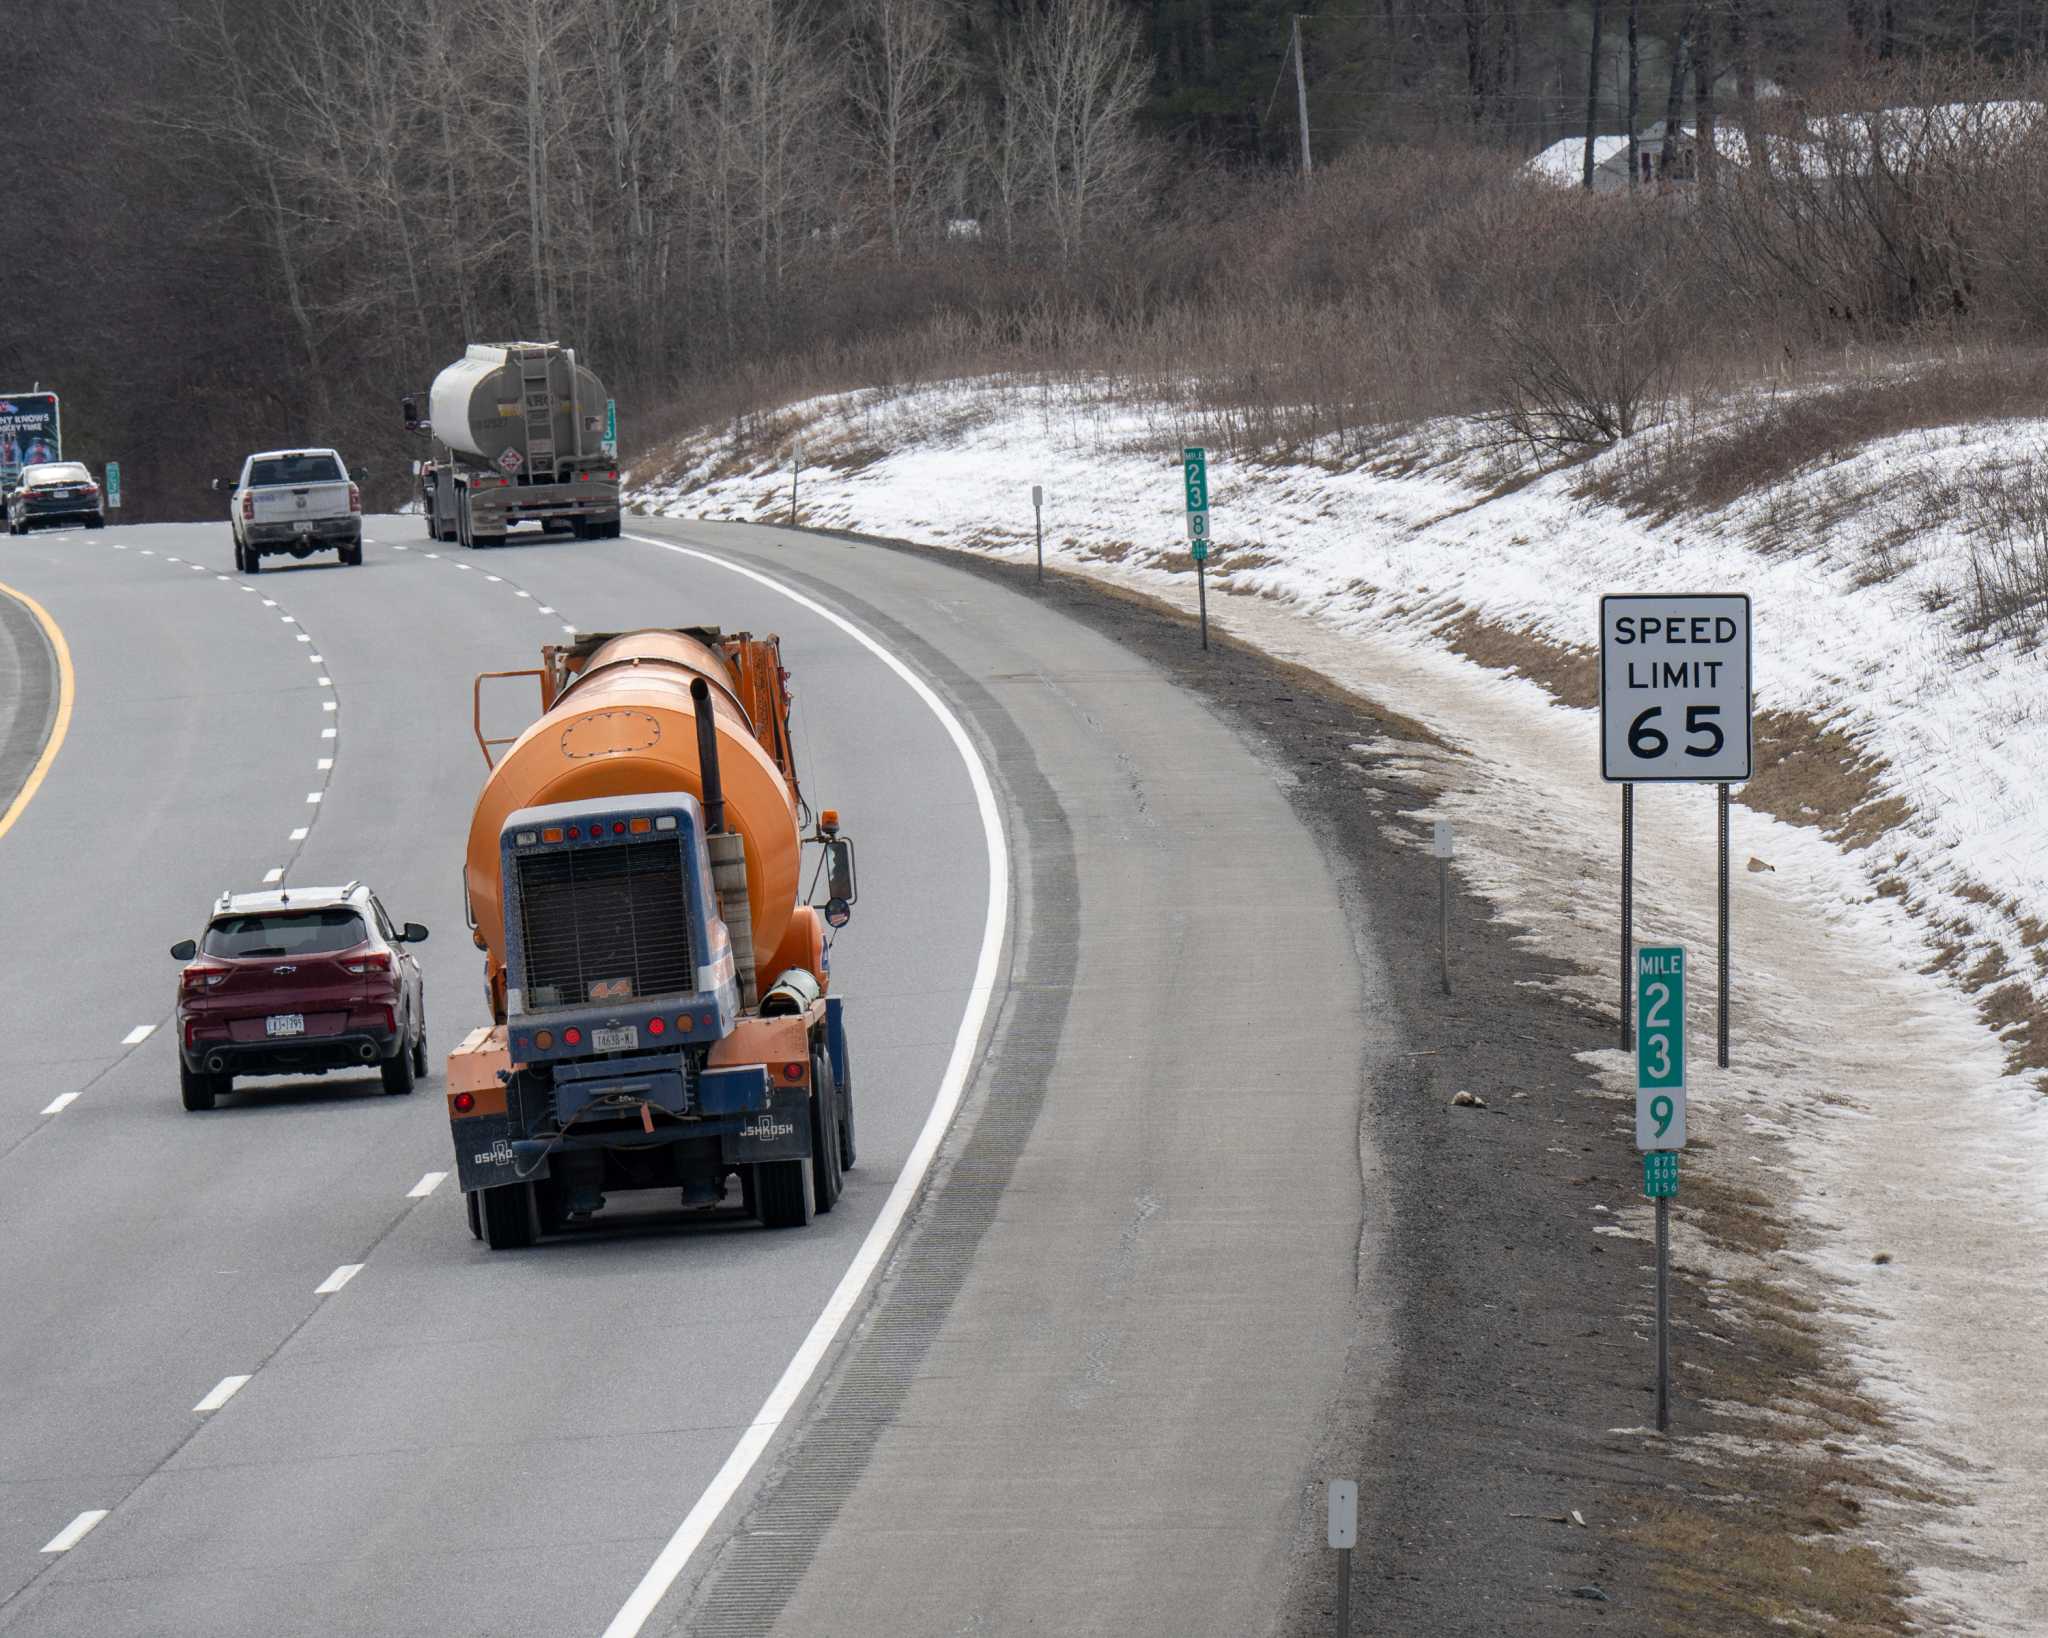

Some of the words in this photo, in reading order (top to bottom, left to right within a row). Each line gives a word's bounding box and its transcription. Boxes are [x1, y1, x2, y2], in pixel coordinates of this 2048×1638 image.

[1615, 617, 1737, 645] SPEED
[1628, 661, 1723, 689] LIMIT
[1628, 706, 1724, 760] 65
[1640, 955, 1681, 975] MILE
[591, 980, 630, 998] 44
[1647, 1168, 1676, 1180] 1509
[1647, 1182, 1676, 1192] 1156
